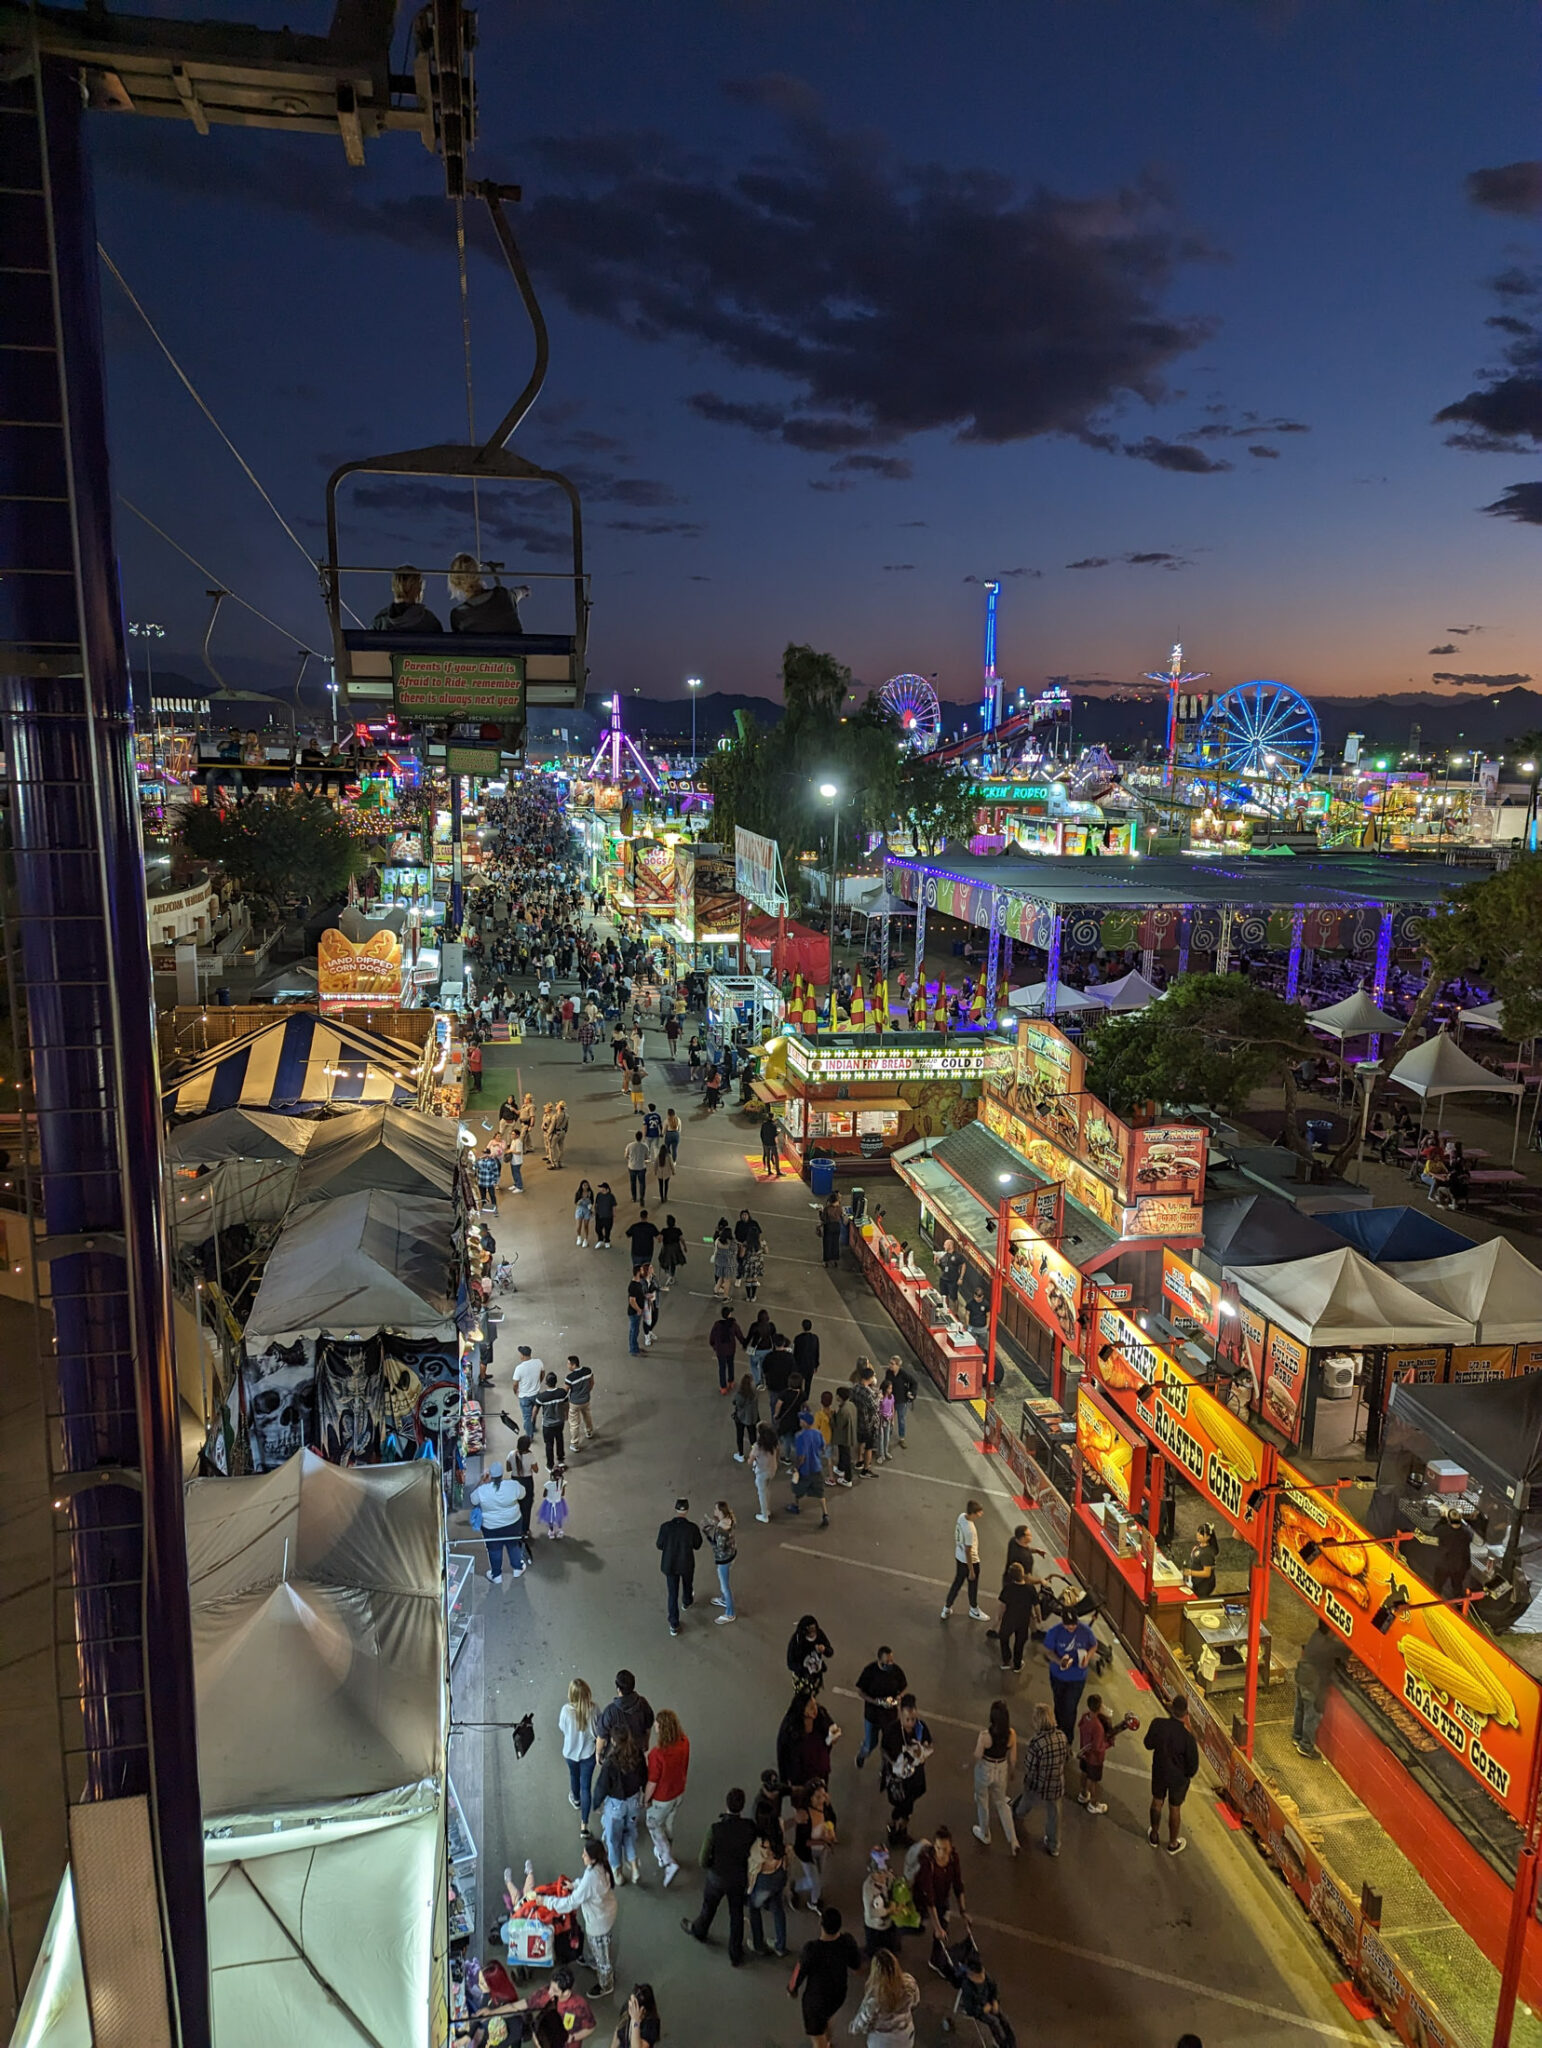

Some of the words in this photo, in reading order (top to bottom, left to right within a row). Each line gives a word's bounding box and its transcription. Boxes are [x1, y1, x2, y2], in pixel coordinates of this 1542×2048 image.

[403, 659, 441, 671] Parents
[443, 661, 453, 673] if
[454, 663, 477, 673] your
[479, 662, 503, 673] Child
[506, 663, 515, 673] is
[398, 675, 429, 688] Afraid
[431, 678, 442, 687] to
[470, 679, 521, 689] remember
[399, 691, 425, 704] there
[427, 692, 436, 703] is
[438, 693, 472, 708] always
[474, 695, 495, 704] next
[497, 696, 519, 707] year
[1013, 787, 1048, 799] RODEO
[646, 849, 668, 857] HOT
[644, 857, 672, 866] DOGS!
[384, 868, 428, 885] Rice
[153, 899, 184, 916] ARIZONA
[324, 957, 353, 969] HAND
[355, 956, 394, 970] DIPPED
[329, 964, 357, 974] CORN
[360, 963, 389, 976] DOGS
[825, 1059, 860, 1070] INDIAN
[862, 1059, 879, 1070] FRY
[881, 1058, 912, 1069] BREAD
[941, 1058, 971, 1068] COLD
[1271, 1342, 1299, 1375] PULLED
[1398, 1360, 1415, 1368] GIANT
[1117, 1318, 1157, 1385] TURKEY
[1160, 1360, 1189, 1419] LEGS
[1273, 1361, 1293, 1389] PORK
[1154, 1397, 1204, 1480] ROASTED
[1208, 1452, 1242, 1518] CORN
[1280, 1545, 1322, 1606] TURKEY
[1325, 1589, 1353, 1637] LEGS
[1454, 1698, 1481, 1738] FRESH
[1404, 1669, 1466, 1754] ROASTED
[1469, 1736, 1511, 1798] CORN
